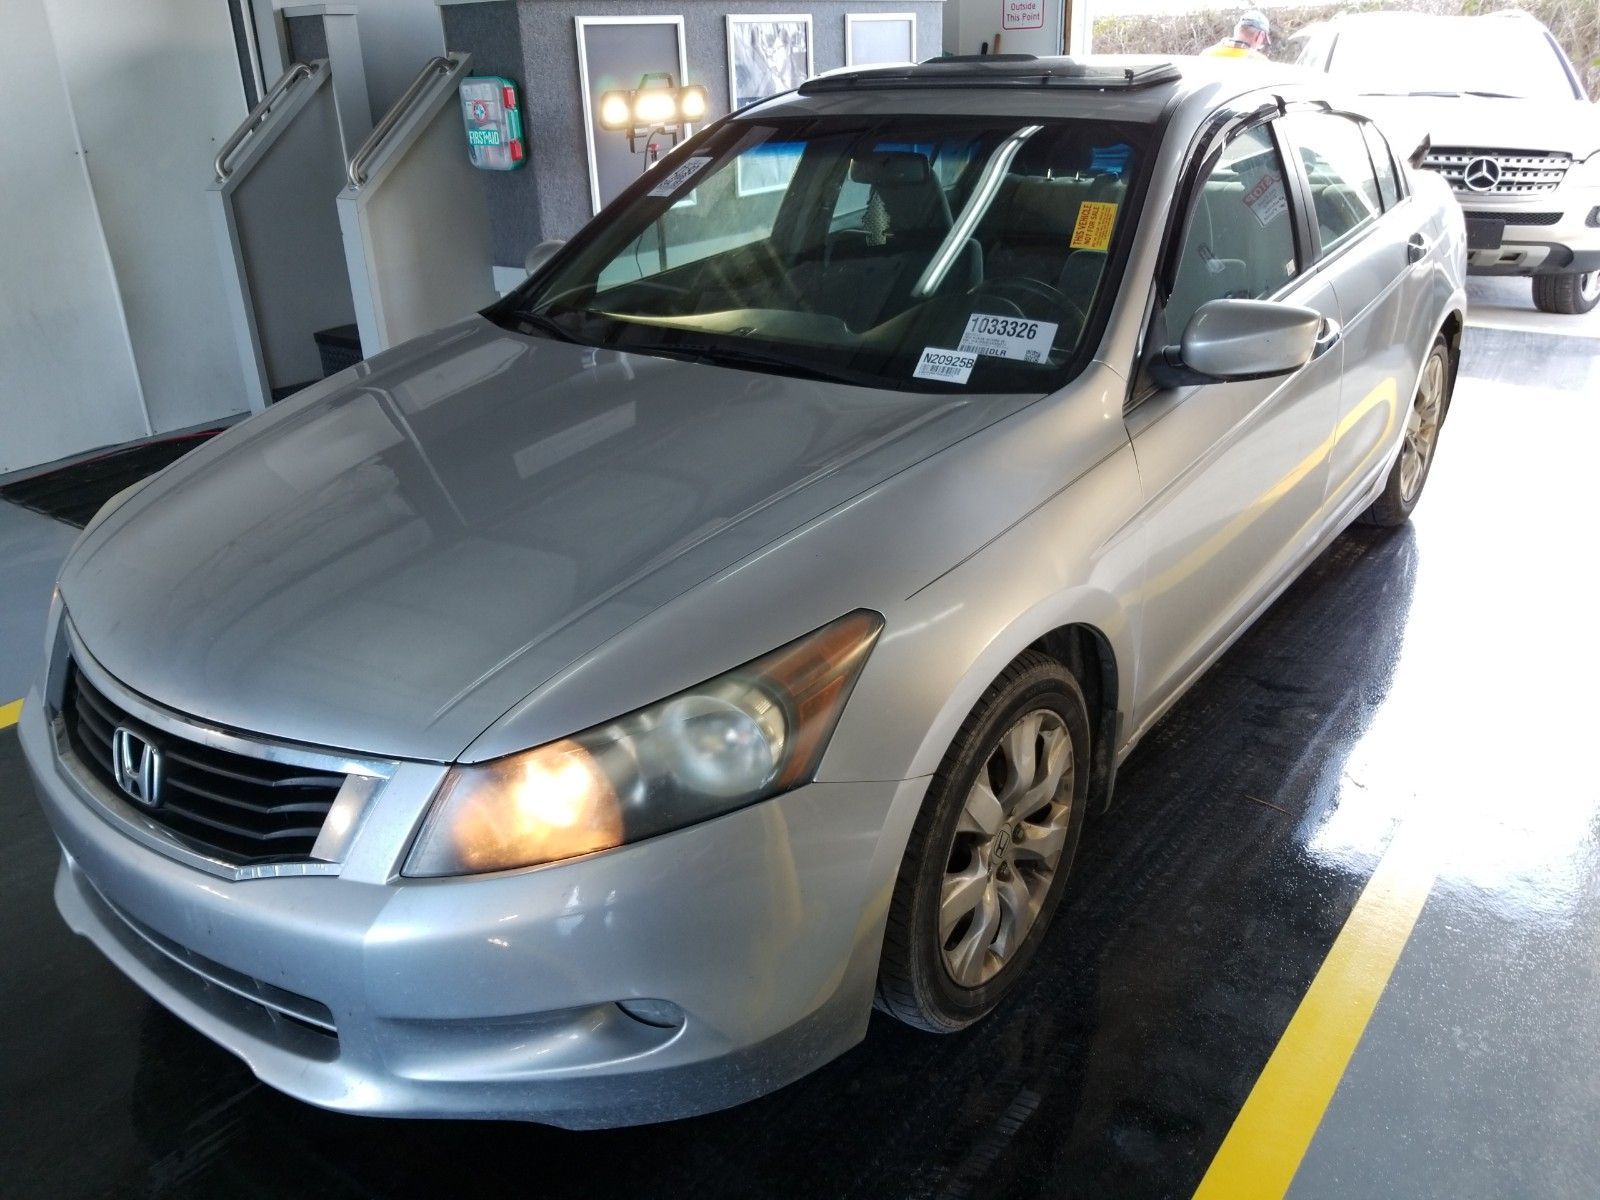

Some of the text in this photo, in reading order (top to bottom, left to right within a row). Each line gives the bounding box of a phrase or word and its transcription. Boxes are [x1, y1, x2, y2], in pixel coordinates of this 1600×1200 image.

[1007, 12, 1040, 22] This Point
[1011, 3, 1036, 11] Outside
[1073, 204, 1092, 245] THIS VEHICLE
[1084, 206, 1100, 245] NOT FOR SALE
[971, 317, 1038, 340] 1033326
[923, 352, 975, 369] N20925B
